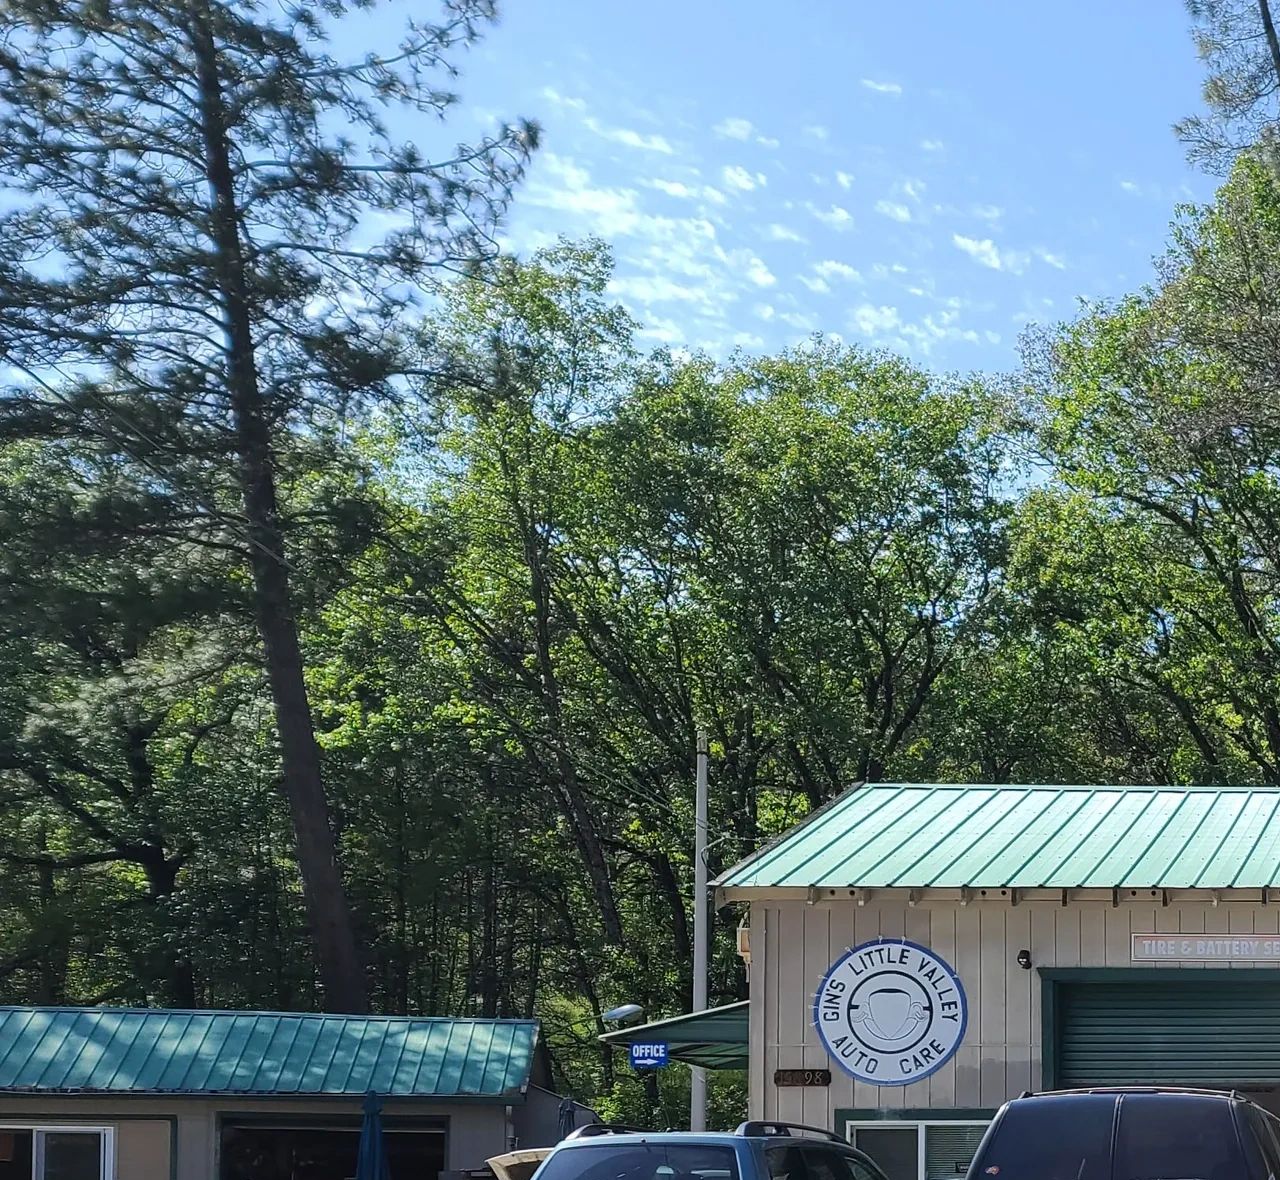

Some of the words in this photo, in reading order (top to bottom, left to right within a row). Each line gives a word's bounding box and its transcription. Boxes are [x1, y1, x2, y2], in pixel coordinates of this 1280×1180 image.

[1142, 940, 1175, 955] TIRE
[1181, 940, 1192, 955] &
[1196, 940, 1259, 956] BATTERY
[823, 979, 846, 1022] GIN'S
[848, 947, 911, 976] LITTLE
[917, 957, 958, 1023] VALLEY
[632, 1044, 665, 1057] OFFICE
[832, 1035, 879, 1075] AUTO
[900, 1038, 946, 1075] CARE
